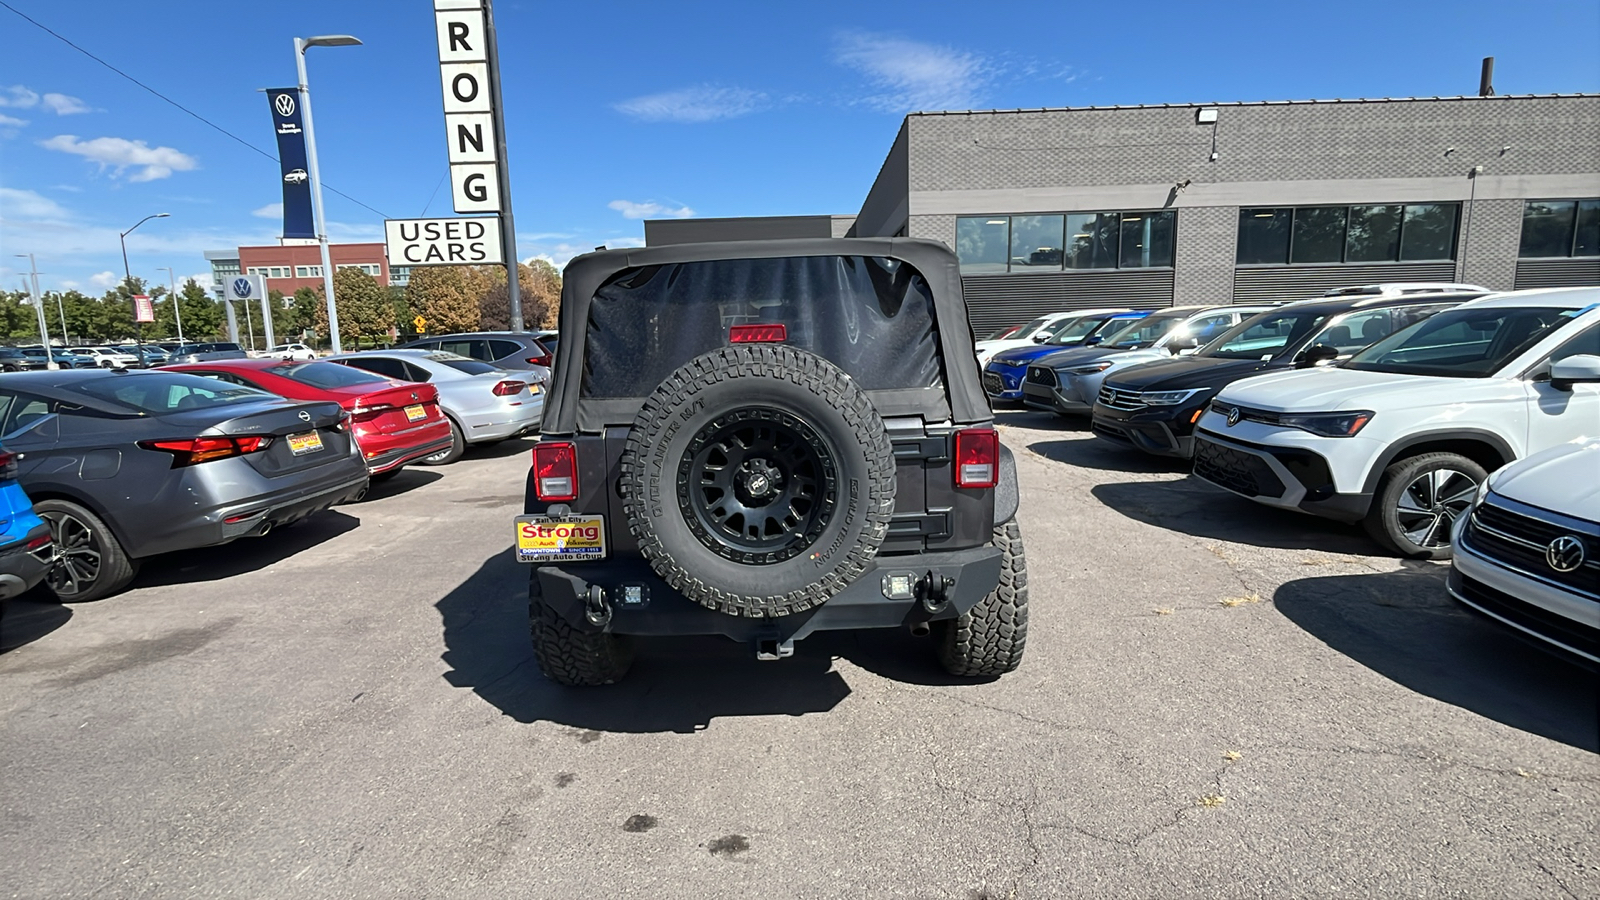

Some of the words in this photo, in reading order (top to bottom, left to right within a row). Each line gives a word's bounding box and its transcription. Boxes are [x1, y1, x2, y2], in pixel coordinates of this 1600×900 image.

[400, 222, 485, 241] USED
[403, 242, 486, 262] CARS
[845, 497, 858, 526] MUD
[522, 525, 599, 541] Strong
[814, 527, 850, 569] TERRAIN
